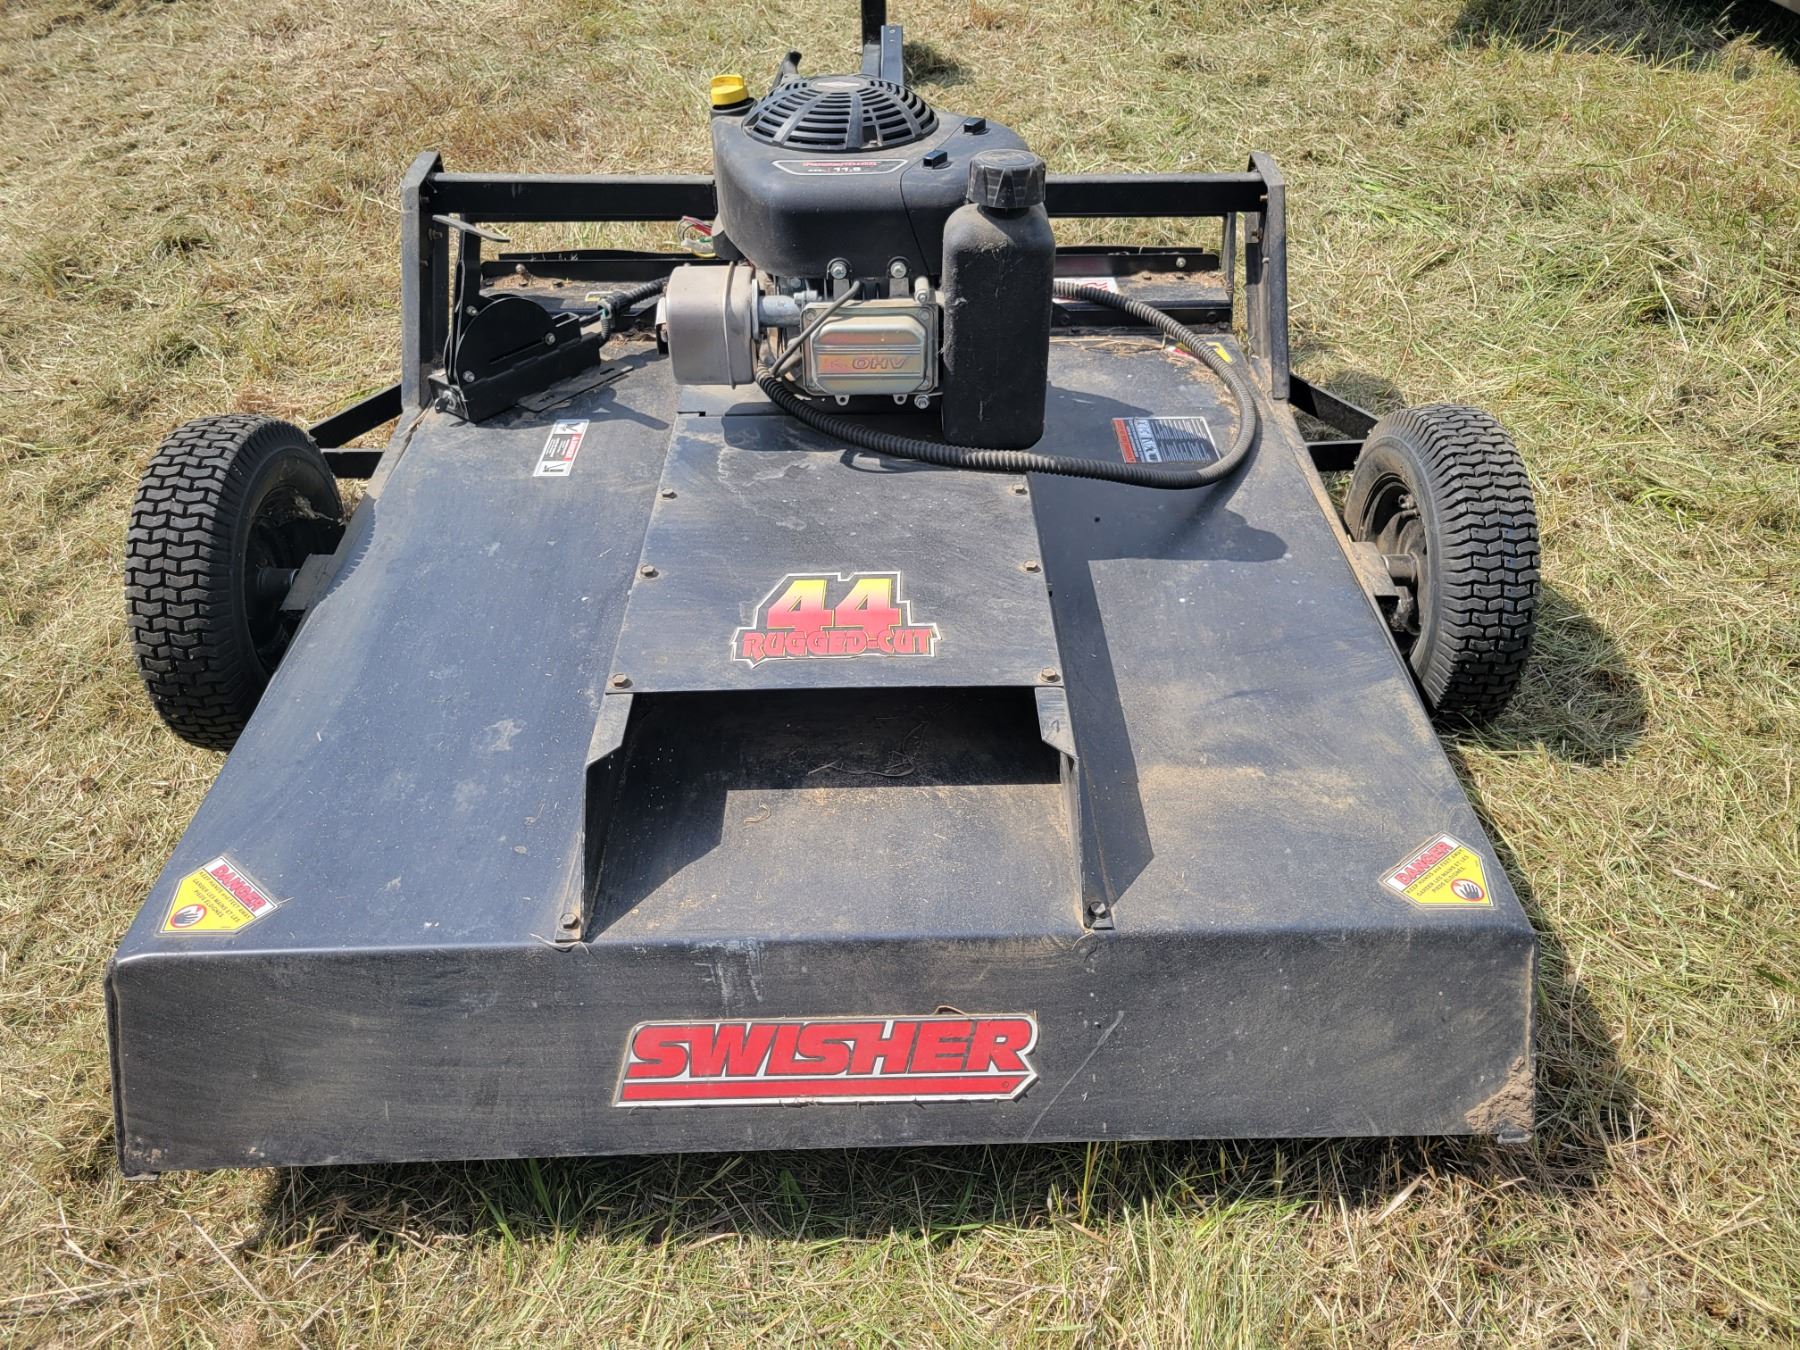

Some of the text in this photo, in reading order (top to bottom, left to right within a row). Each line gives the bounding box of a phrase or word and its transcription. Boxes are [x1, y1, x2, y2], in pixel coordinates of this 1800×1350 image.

[852, 357, 907, 370] OHV
[767, 578, 901, 633] 44
[743, 629, 932, 660] RUGGED-CUT
[1395, 841, 1453, 885] DANGER
[211, 864, 266, 912] DANGER
[626, 1018, 1032, 1079] SWISHER
